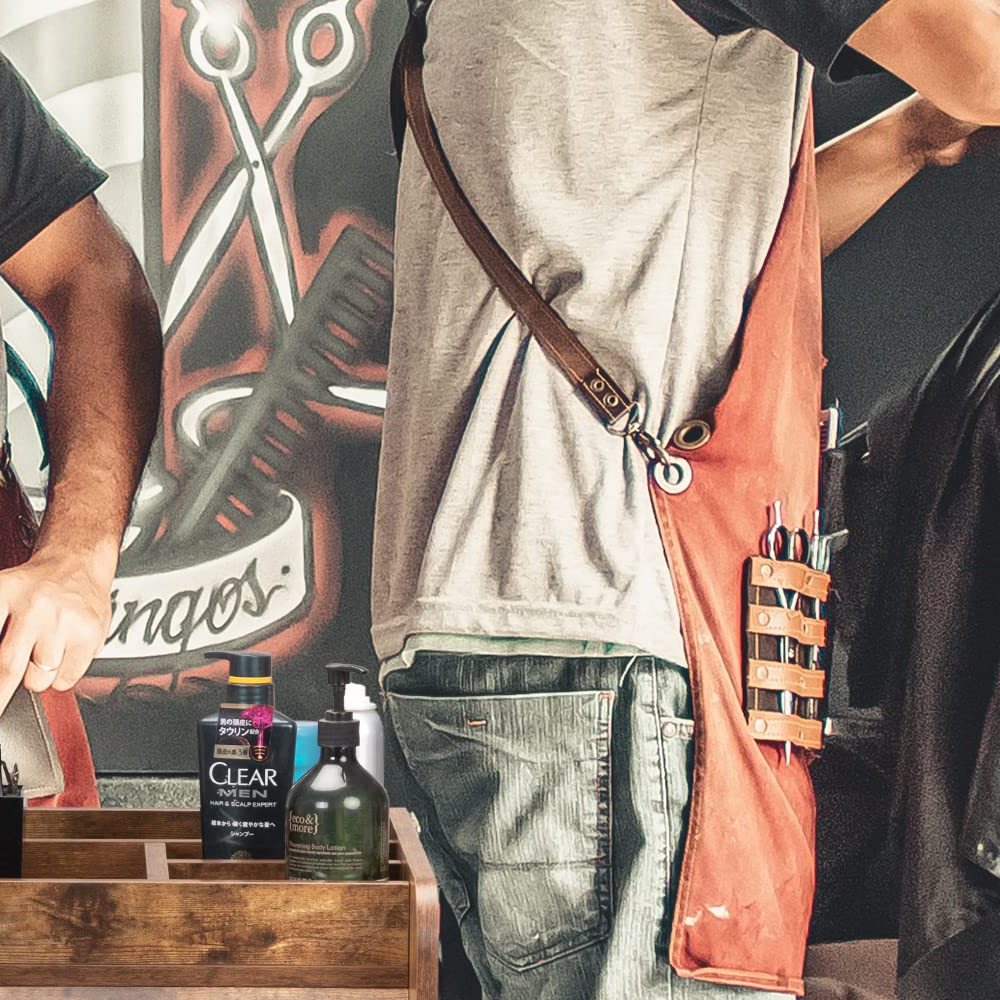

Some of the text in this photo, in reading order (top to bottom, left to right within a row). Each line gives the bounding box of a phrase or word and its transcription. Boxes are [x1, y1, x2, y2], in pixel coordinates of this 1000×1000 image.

[209, 761, 278, 786] CLEAR
[218, 788, 268, 798] MEN
[311, 843, 325, 851] Body
